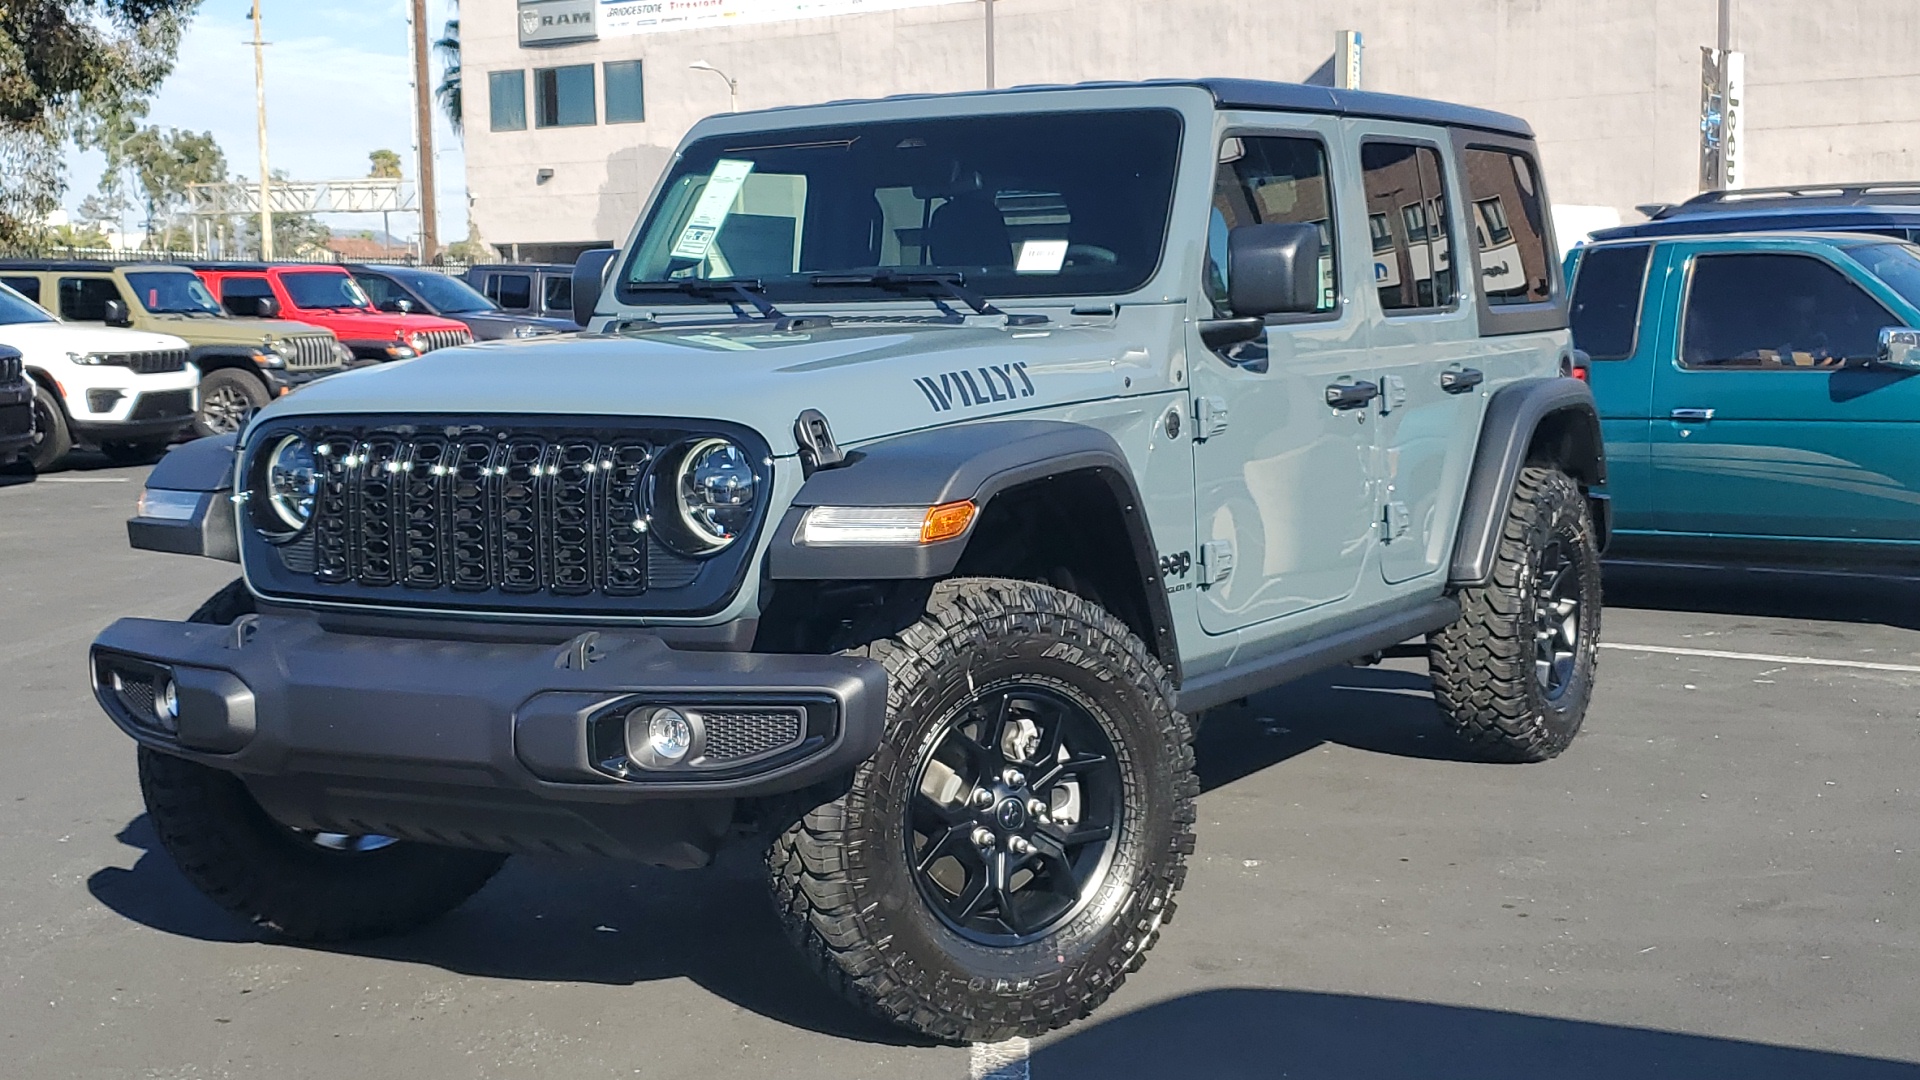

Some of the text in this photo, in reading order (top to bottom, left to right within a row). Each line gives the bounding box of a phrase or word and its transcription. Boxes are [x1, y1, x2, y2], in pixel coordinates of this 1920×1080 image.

[542, 12, 591, 26] RAM
[606, 3, 662, 17] BRIDGESTONE
[912, 361, 1035, 412] WILLYS
[1158, 550, 1191, 579] eep
